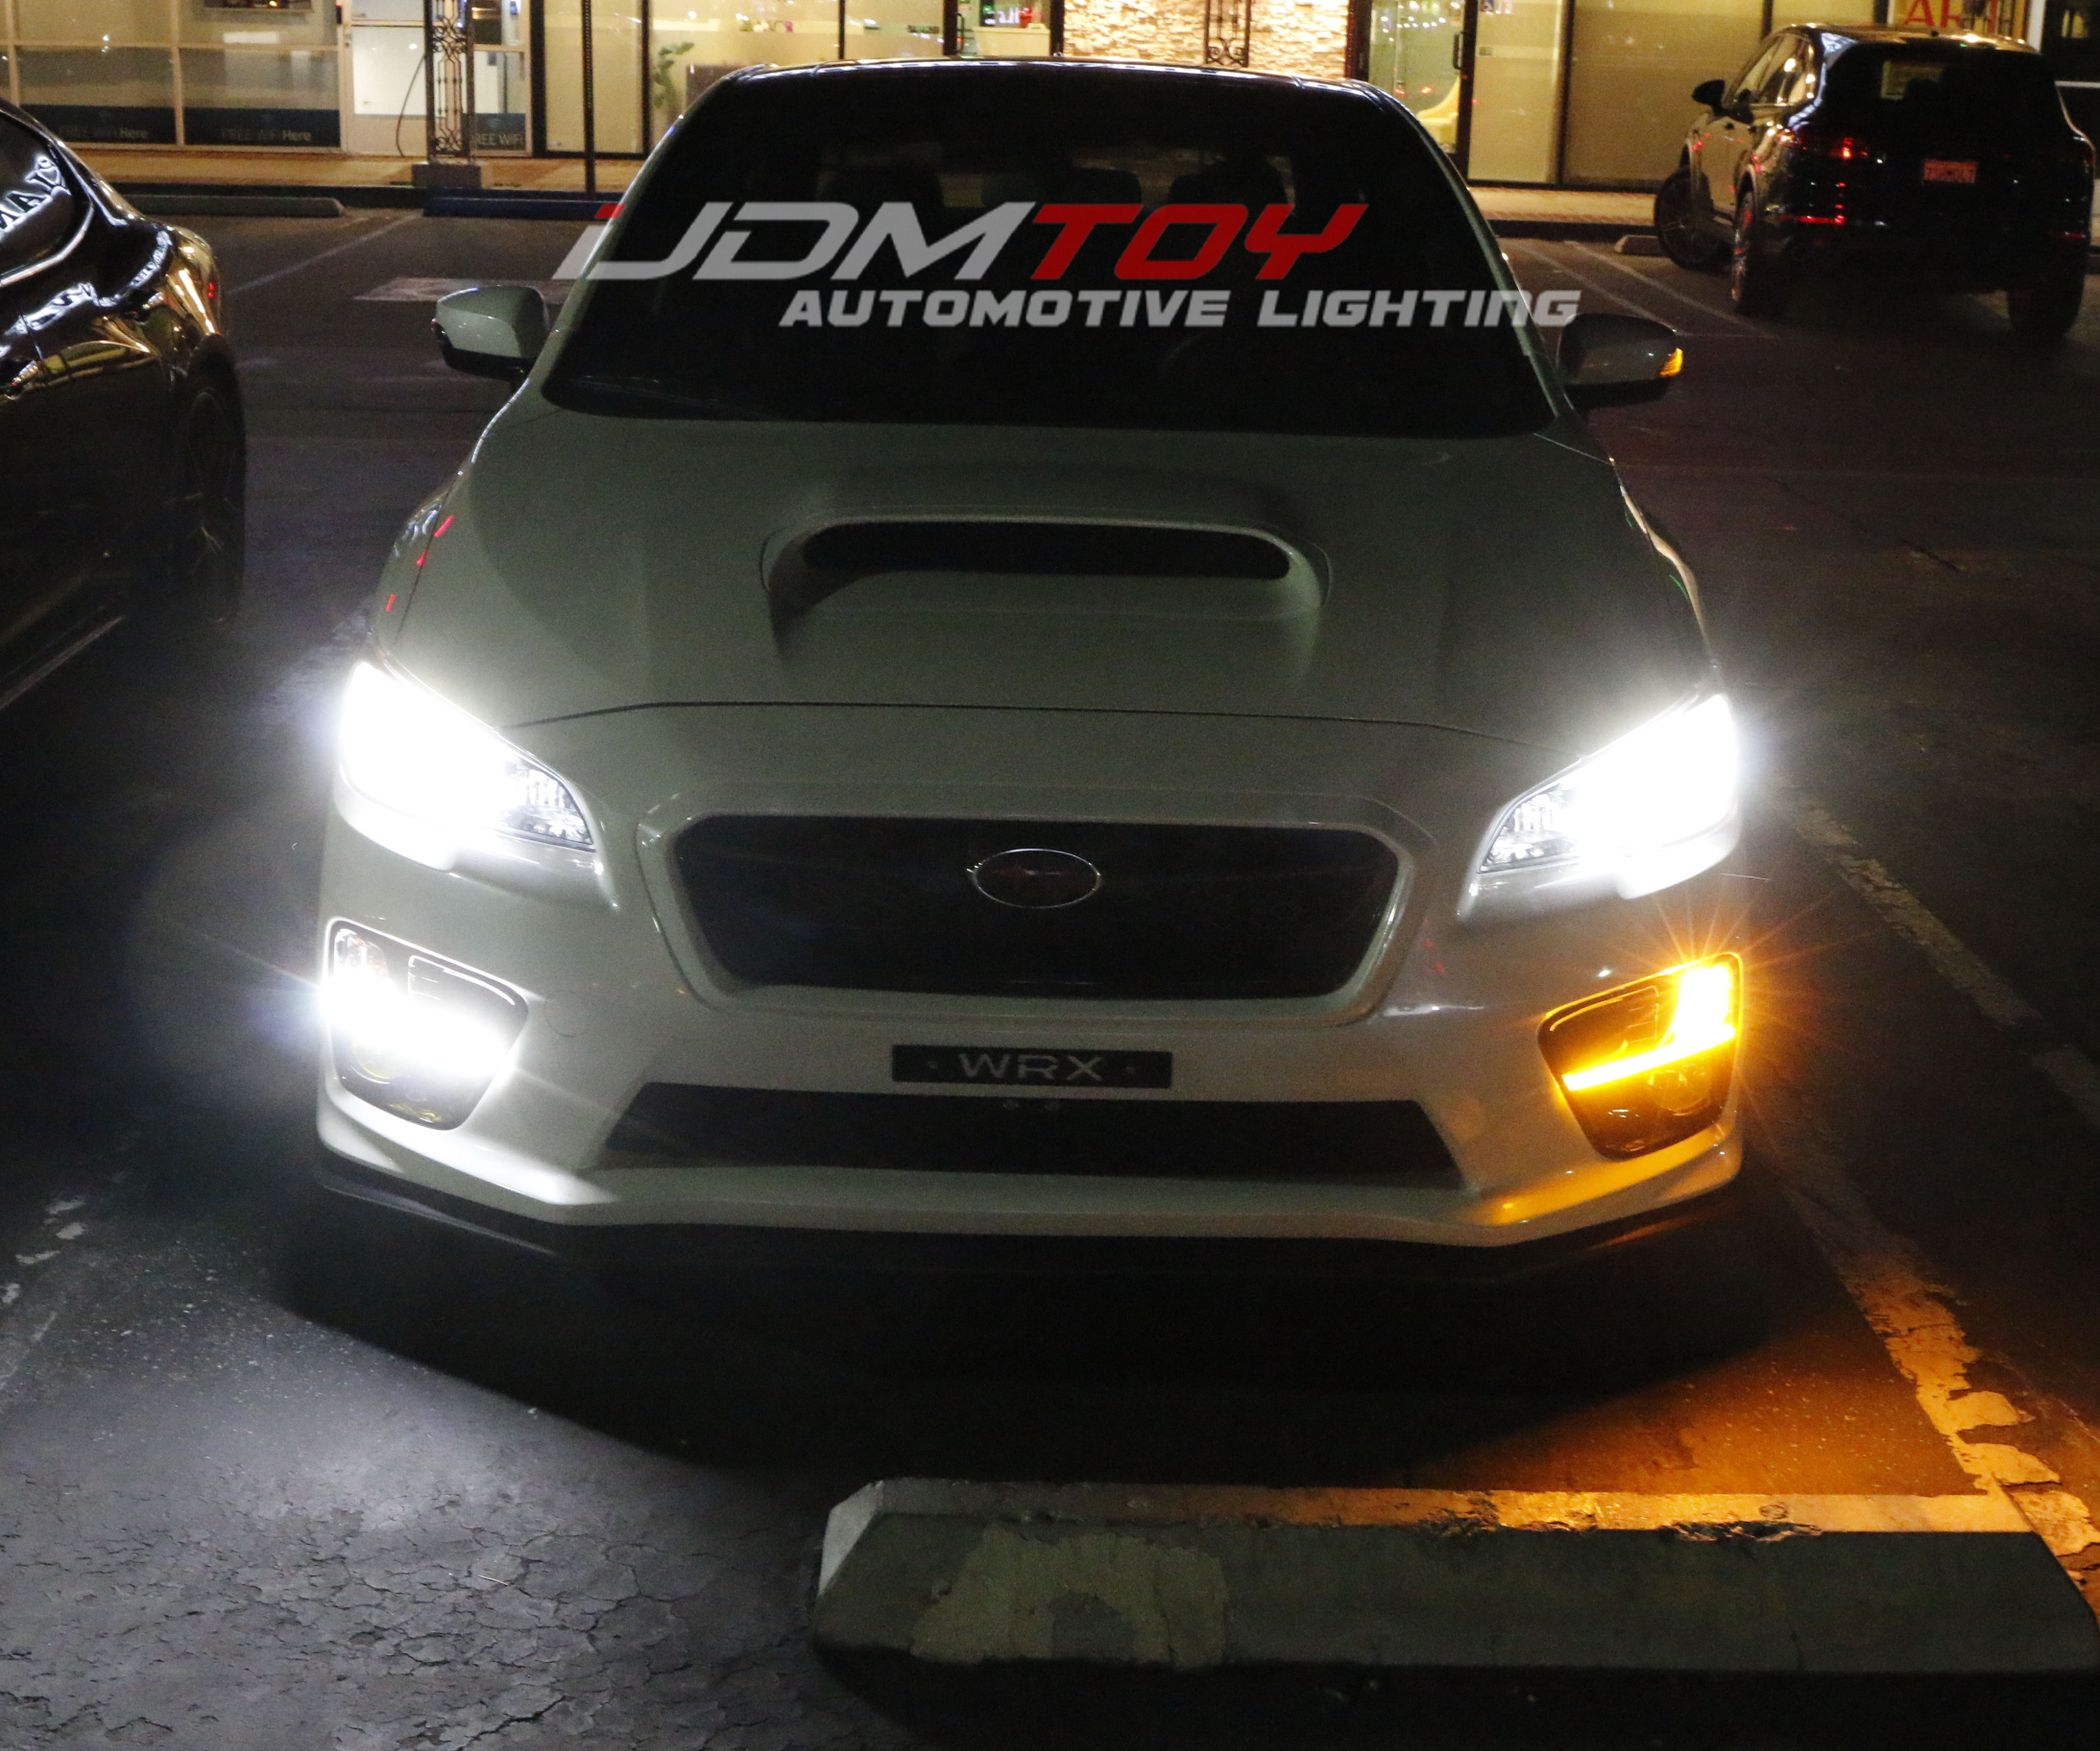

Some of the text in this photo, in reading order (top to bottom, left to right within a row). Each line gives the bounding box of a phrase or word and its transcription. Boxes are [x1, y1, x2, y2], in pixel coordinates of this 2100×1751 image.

[119, 127, 148, 139] Here
[282, 129, 312, 142] Here
[958, 1053, 1105, 1082] WRX
